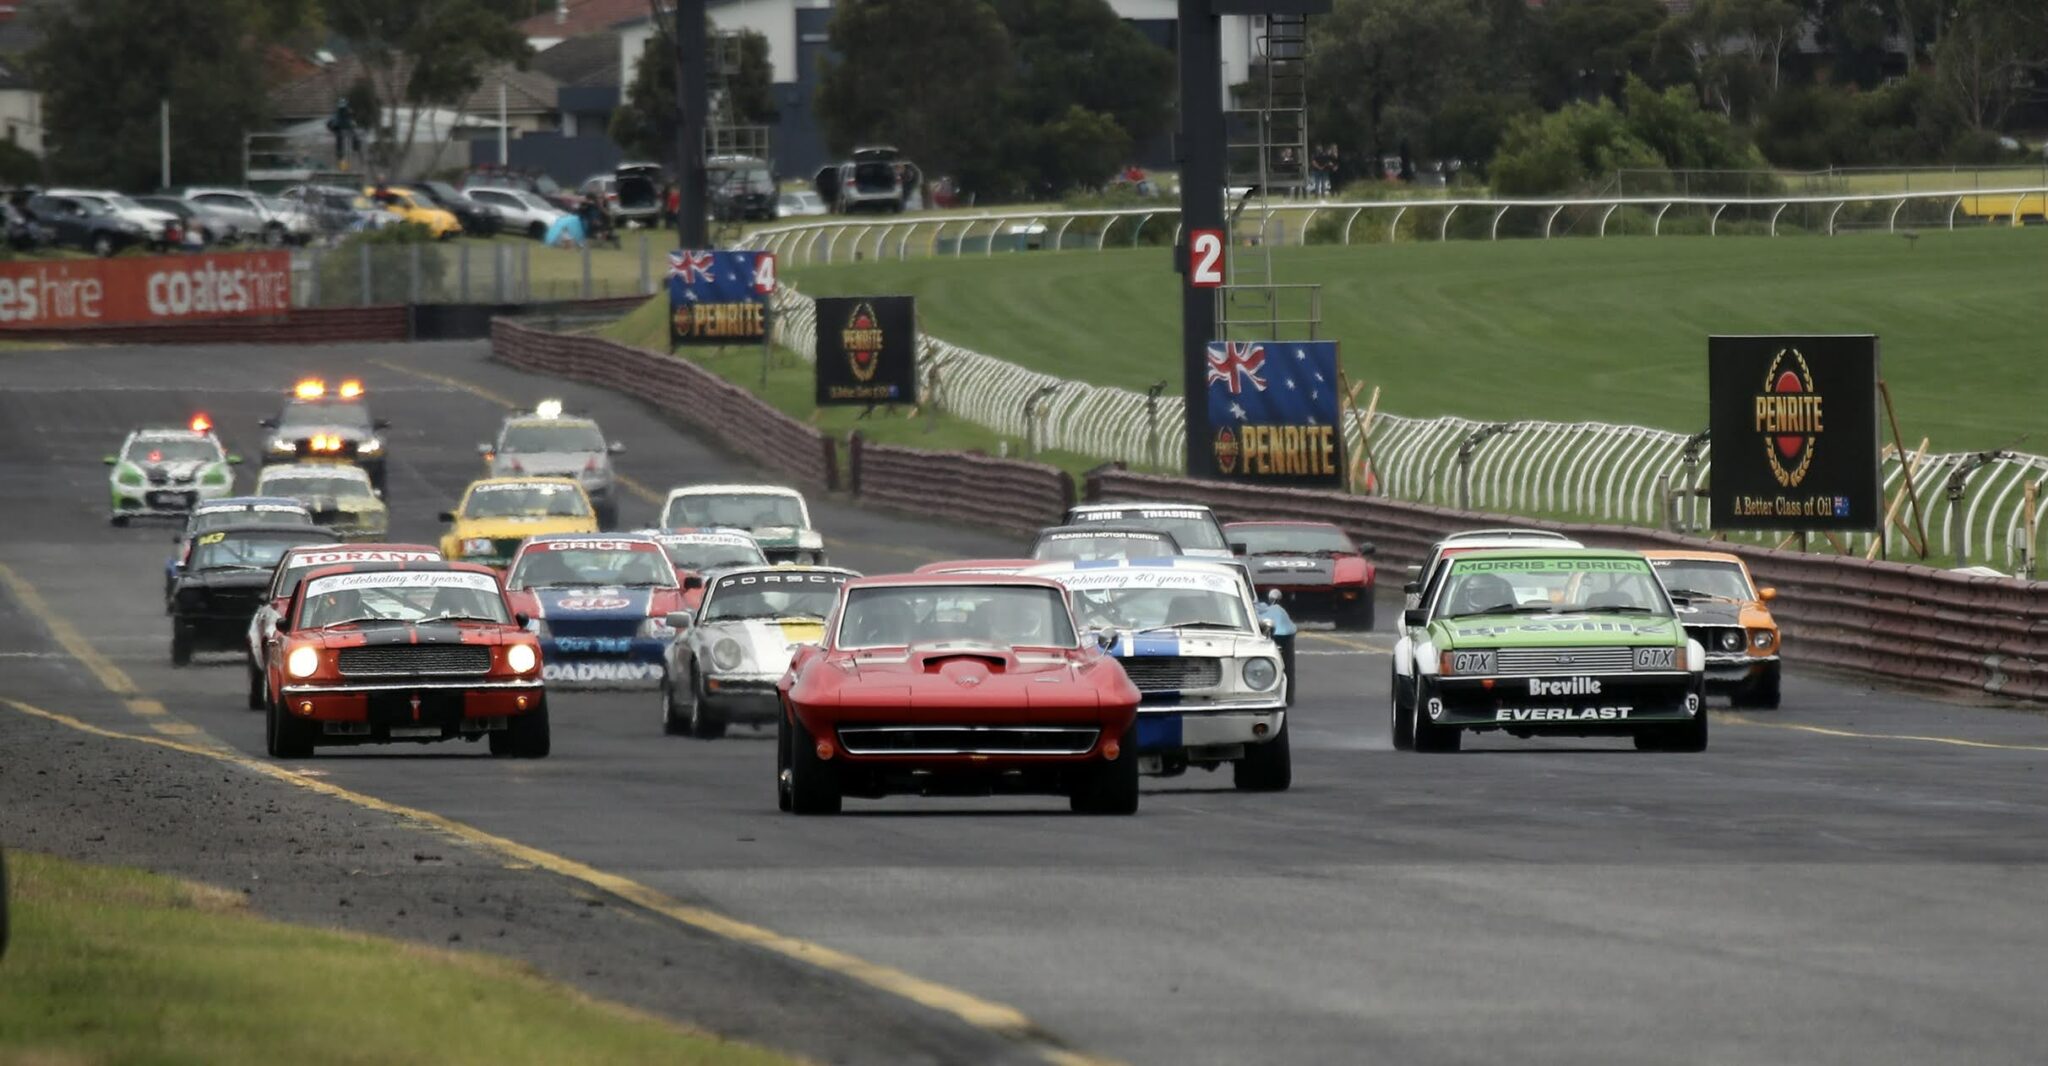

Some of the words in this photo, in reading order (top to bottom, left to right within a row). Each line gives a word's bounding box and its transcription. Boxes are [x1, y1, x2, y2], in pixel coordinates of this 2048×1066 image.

[1194, 233, 1222, 283] 2
[755, 256, 775, 292] 4
[694, 303, 764, 336] PENRITE
[1756, 396, 1823, 432] PENRITE
[1241, 425, 1335, 475] PENRITE
[1141, 511, 1203, 519] TREASURE
[1734, 497, 1742, 515] A
[1744, 497, 1773, 515] Better
[1776, 496, 1801, 515] Class
[1804, 496, 1815, 515] of
[1817, 496, 1832, 516] Oil
[549, 542, 631, 550] GRICE
[1128, 533, 1160, 541] WORKS
[303, 553, 429, 564] TORANA
[341, 576, 409, 586] Celebrating
[412, 574, 428, 584] 40
[429, 574, 464, 585] years
[722, 575, 846, 588] PORSCH
[1135, 573, 1154, 582] 40
[1157, 574, 1196, 587] years
[1455, 653, 1490, 671] GTX
[1638, 649, 1673, 667] GTX
[543, 662, 664, 681] OADWAYS
[1529, 677, 1601, 696] Breville
[1496, 706, 1633, 721] EVERLAST
